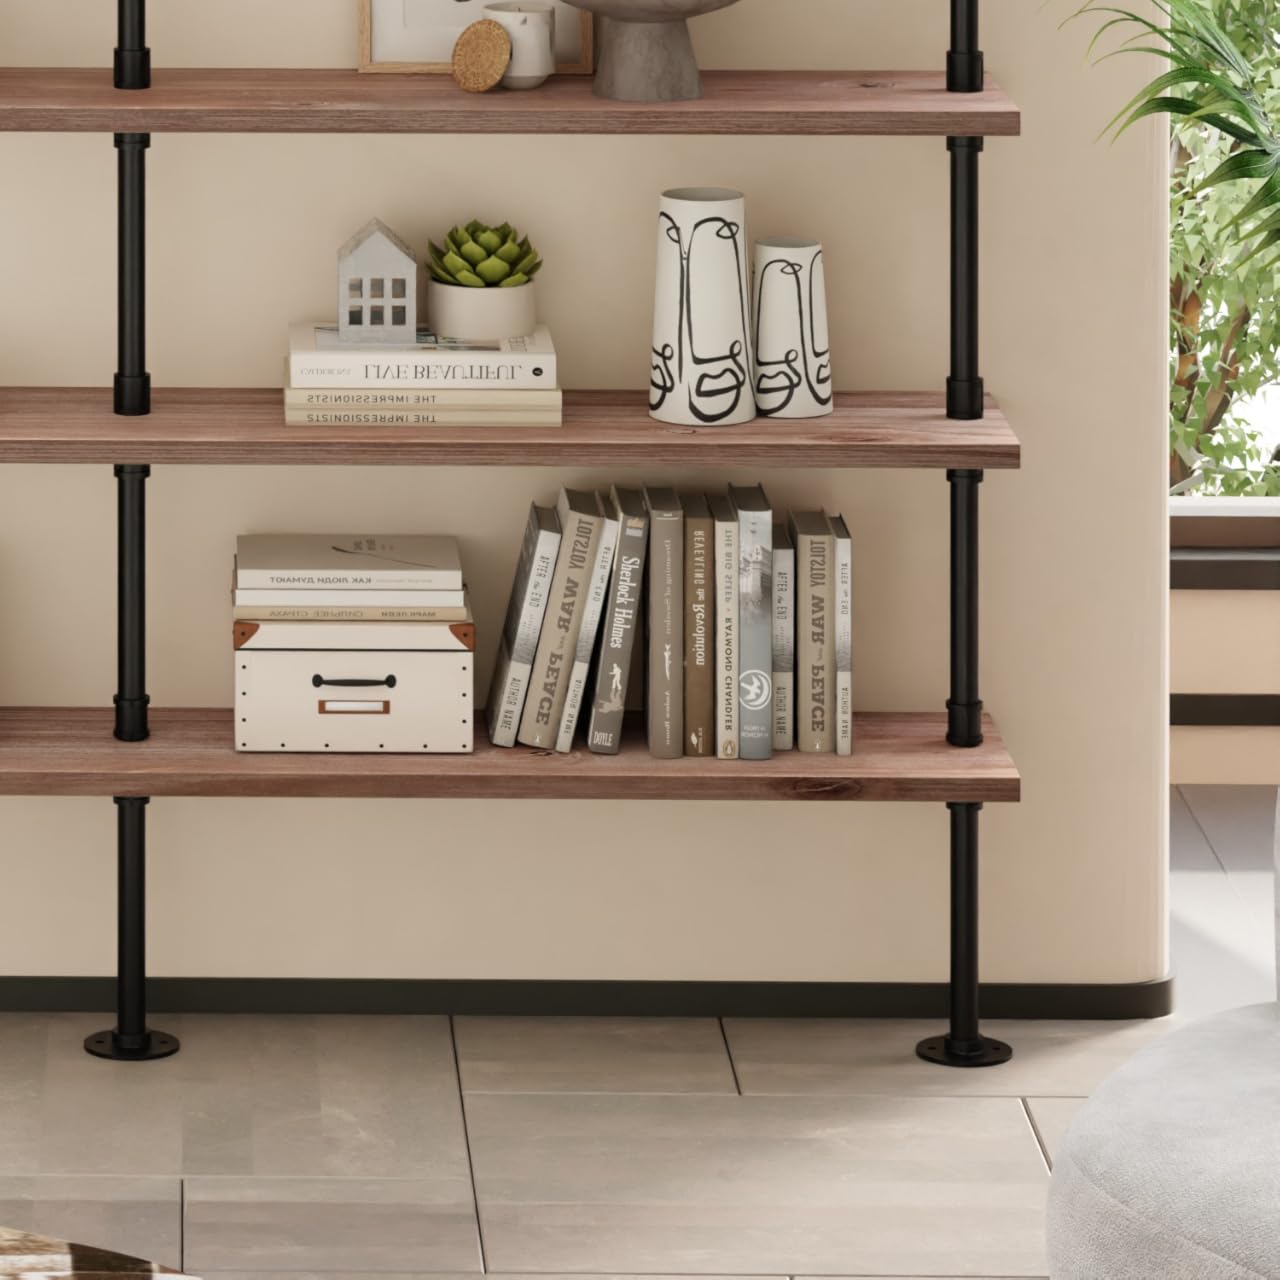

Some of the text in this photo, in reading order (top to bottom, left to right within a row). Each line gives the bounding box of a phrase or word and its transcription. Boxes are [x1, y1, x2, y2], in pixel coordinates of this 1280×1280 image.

[307, 414, 436, 422] THE IMPRESSIONISTS
[610, 556, 640, 649] Sherlock Holmes
[500, 678, 521, 730] AUTHOR NAME
[776, 686, 787, 735] AUTHOR NAME
[594, 732, 612, 746] DOYLE
